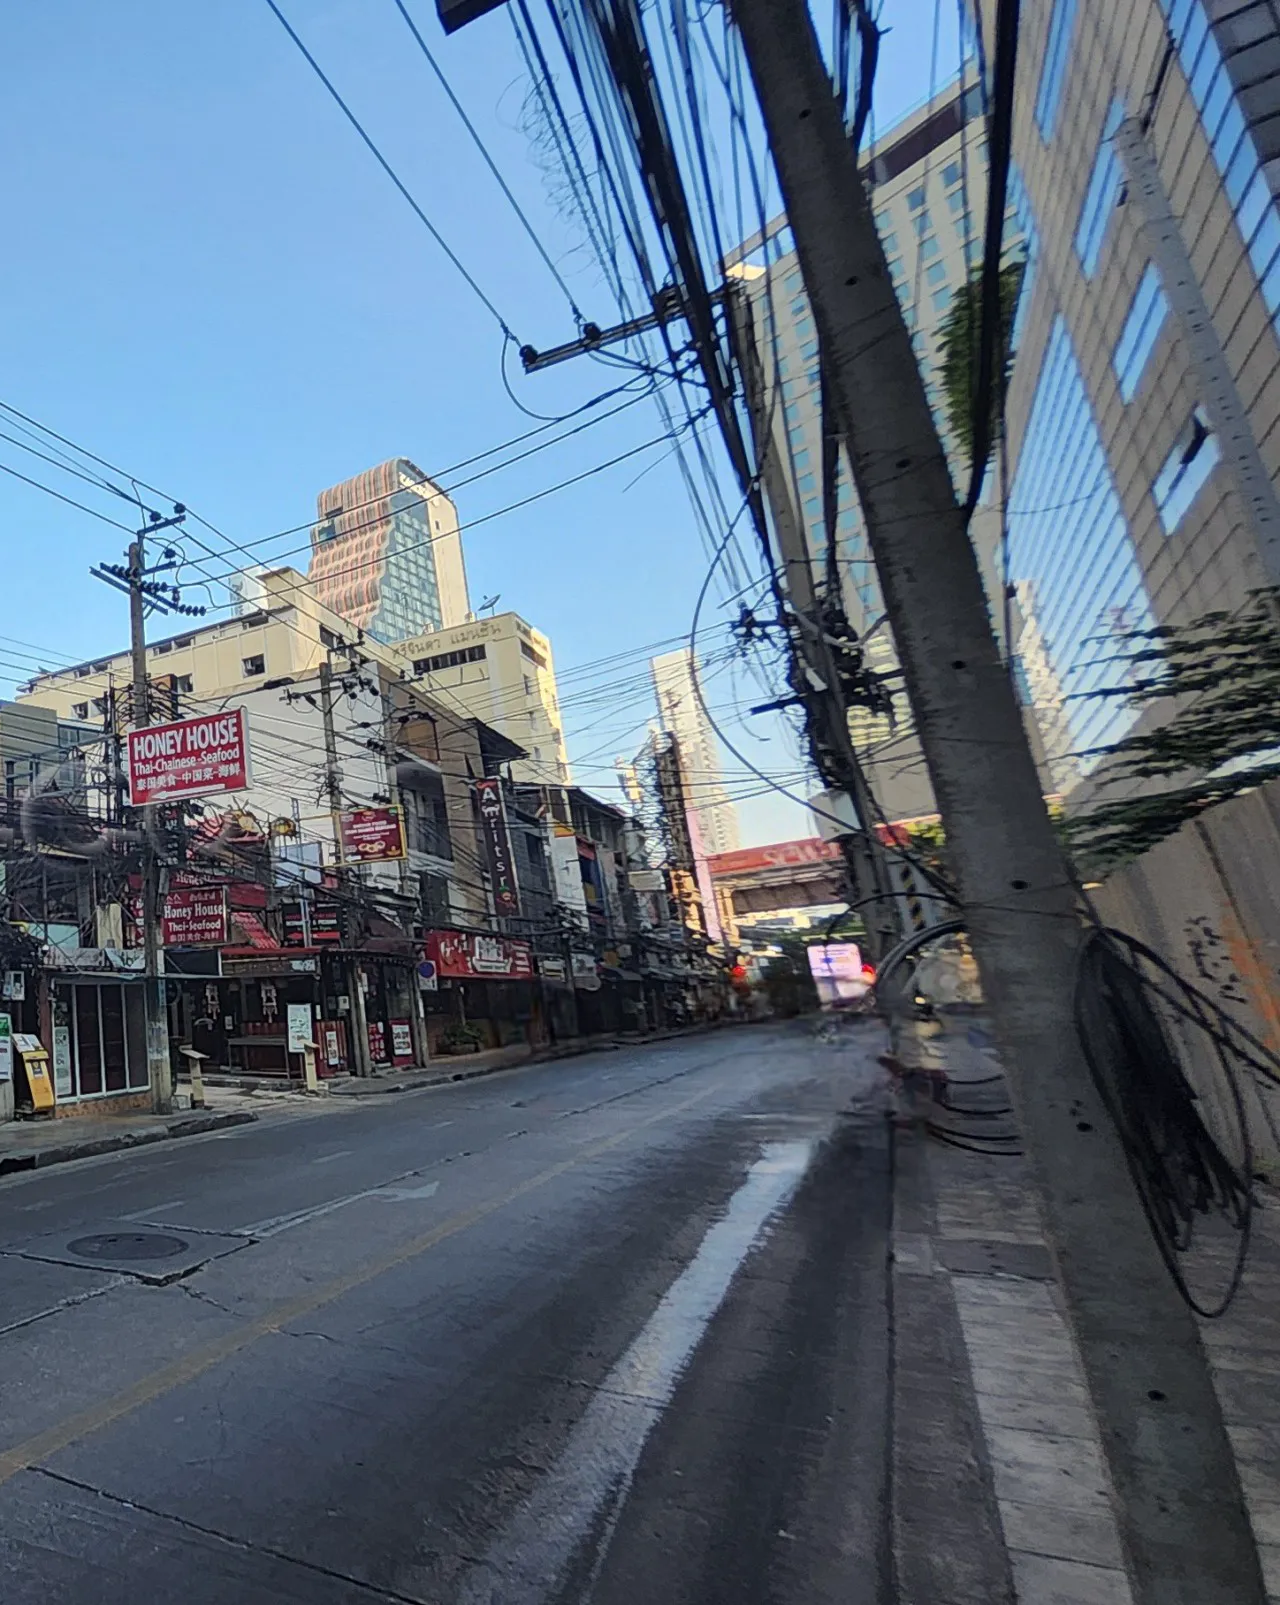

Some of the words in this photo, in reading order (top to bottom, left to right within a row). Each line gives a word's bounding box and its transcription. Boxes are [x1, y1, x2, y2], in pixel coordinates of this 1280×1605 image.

[134, 728, 184, 761] HONEY
[186, 718, 239, 751] HOUSE
[163, 905, 193, 920] Honey
[194, 902, 223, 917] House
